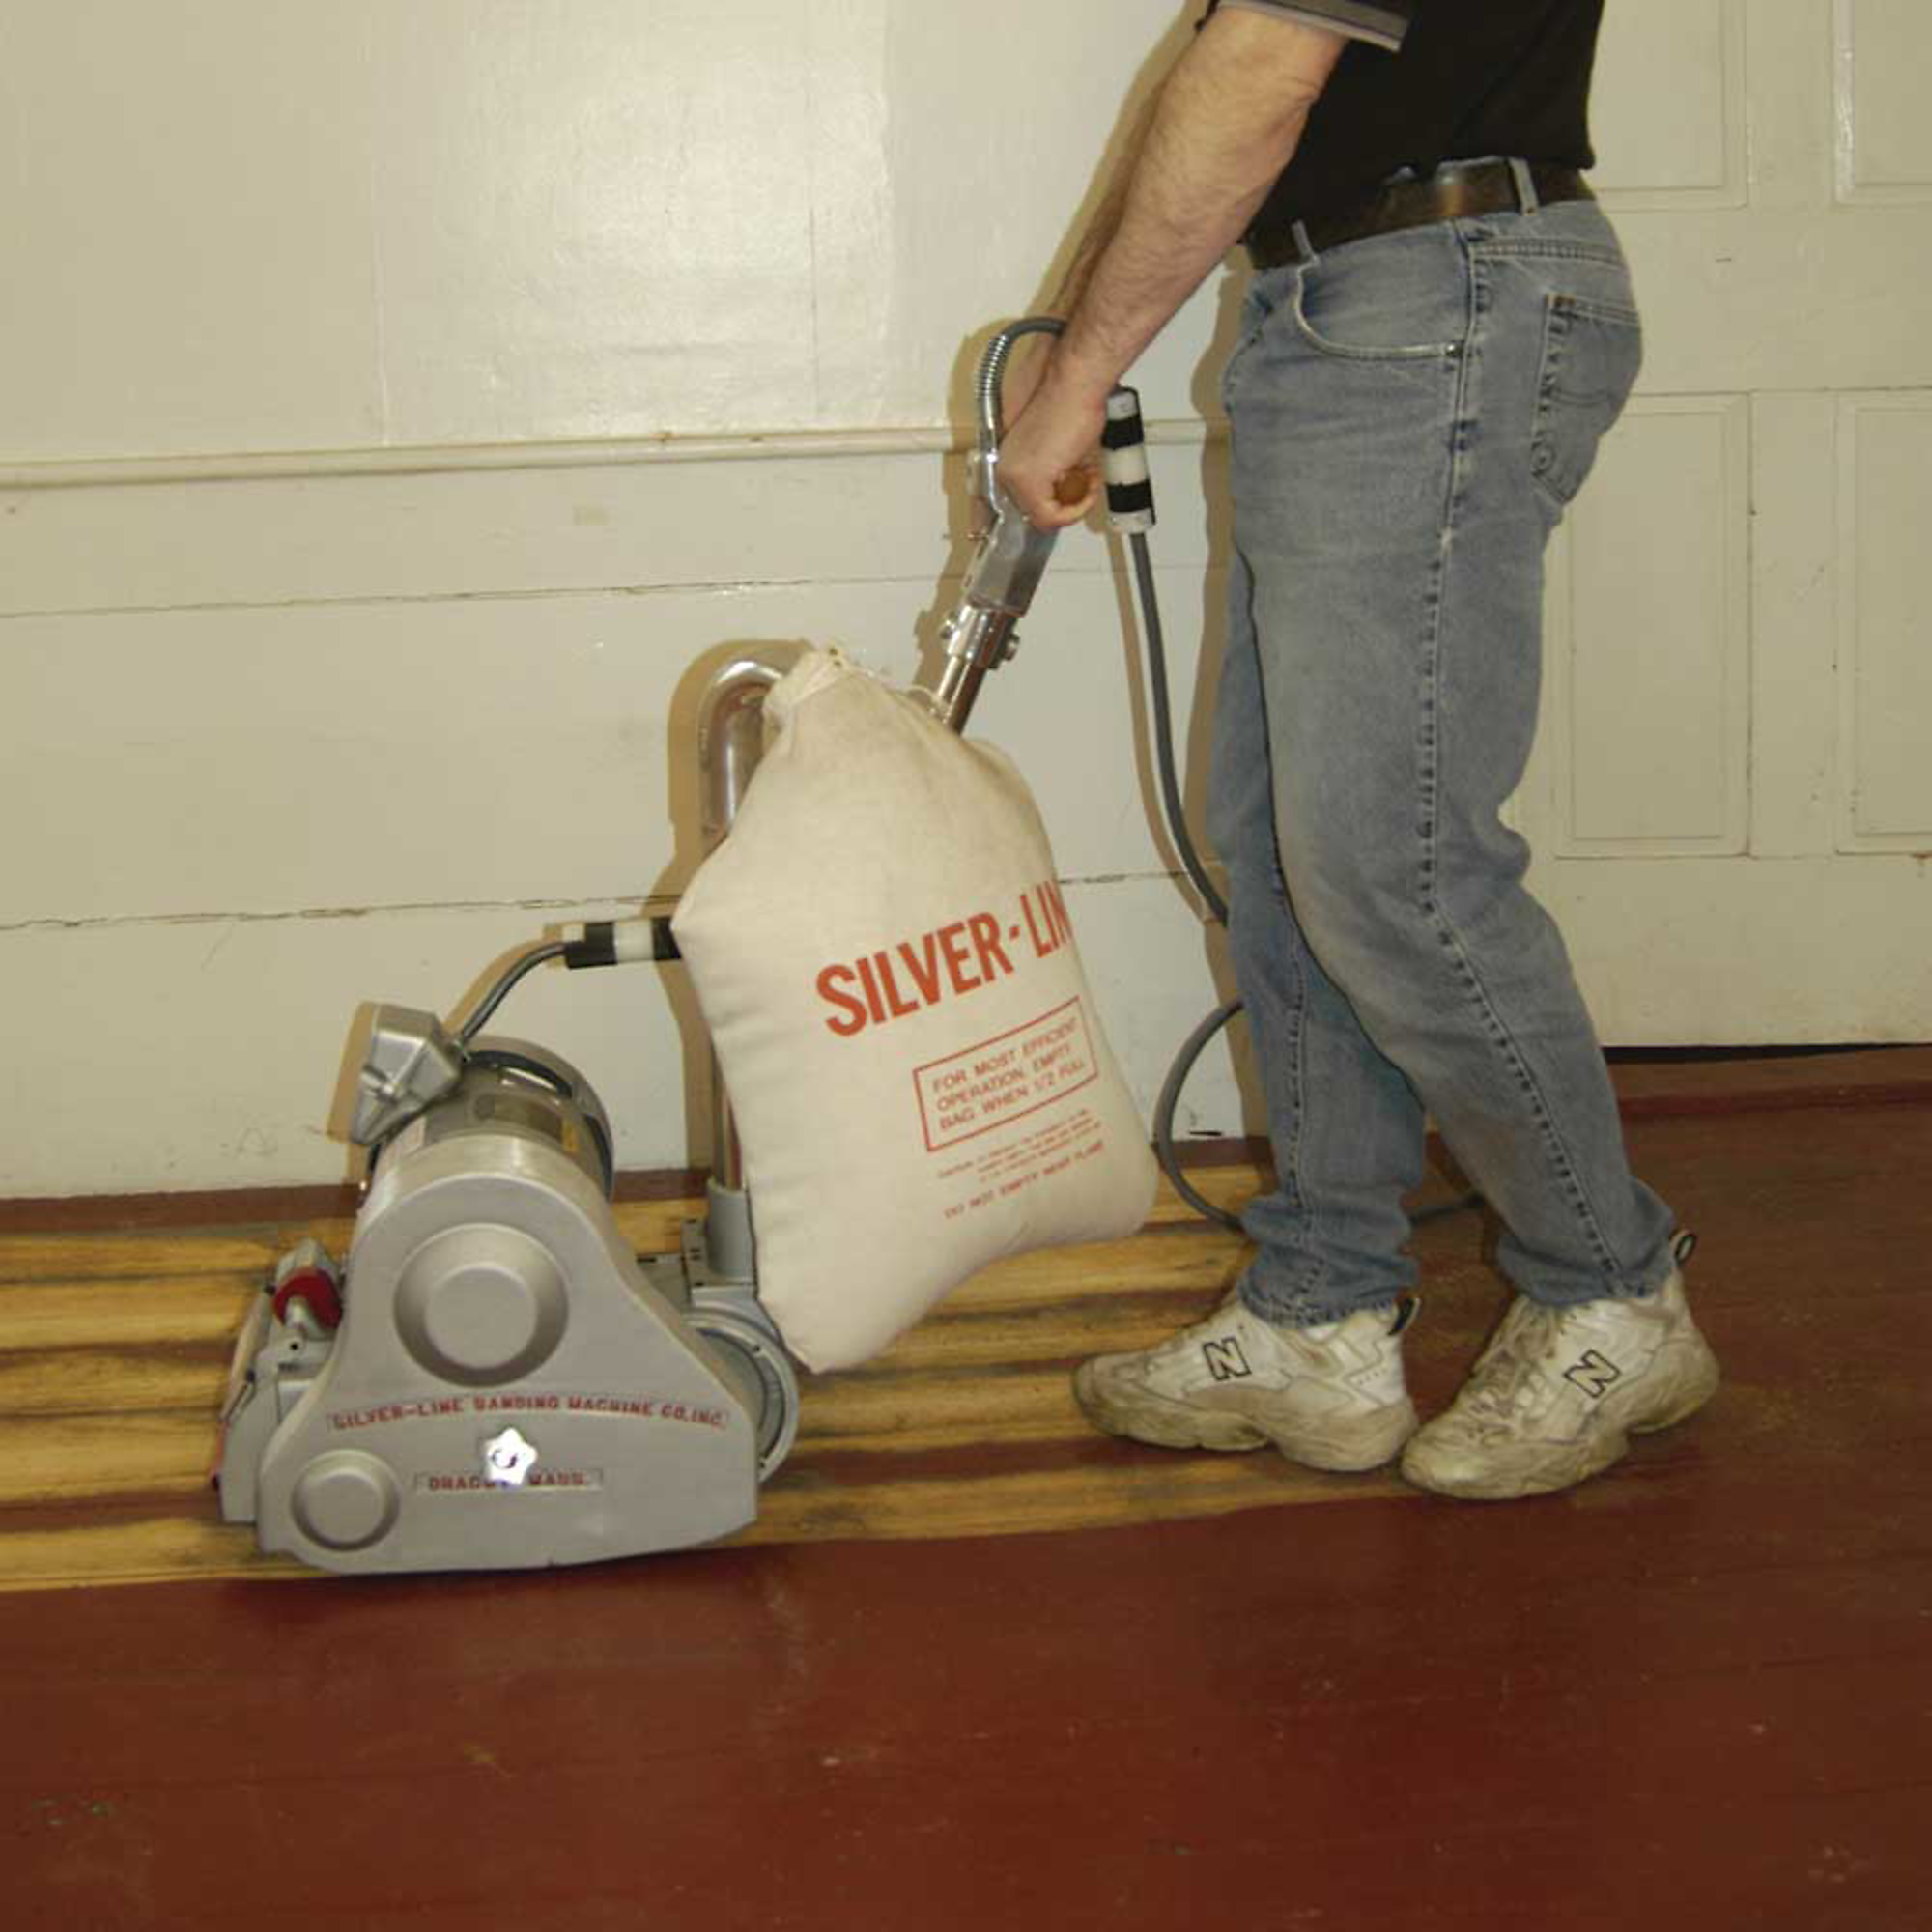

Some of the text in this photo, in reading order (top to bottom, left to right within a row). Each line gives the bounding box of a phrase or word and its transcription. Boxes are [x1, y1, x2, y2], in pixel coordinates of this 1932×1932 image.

[933, 1069, 967, 1094] FOR
[974, 1050, 1016, 1077] MOST
[936, 1067, 1026, 1112] OPERATION
[939, 1106, 975, 1132] BAG
[981, 1085, 1029, 1113] WHEN
[333, 1397, 464, 1431] SILVER-LINE
[473, 1395, 559, 1412] SANDING
[568, 1397, 655, 1417] MACHINE
